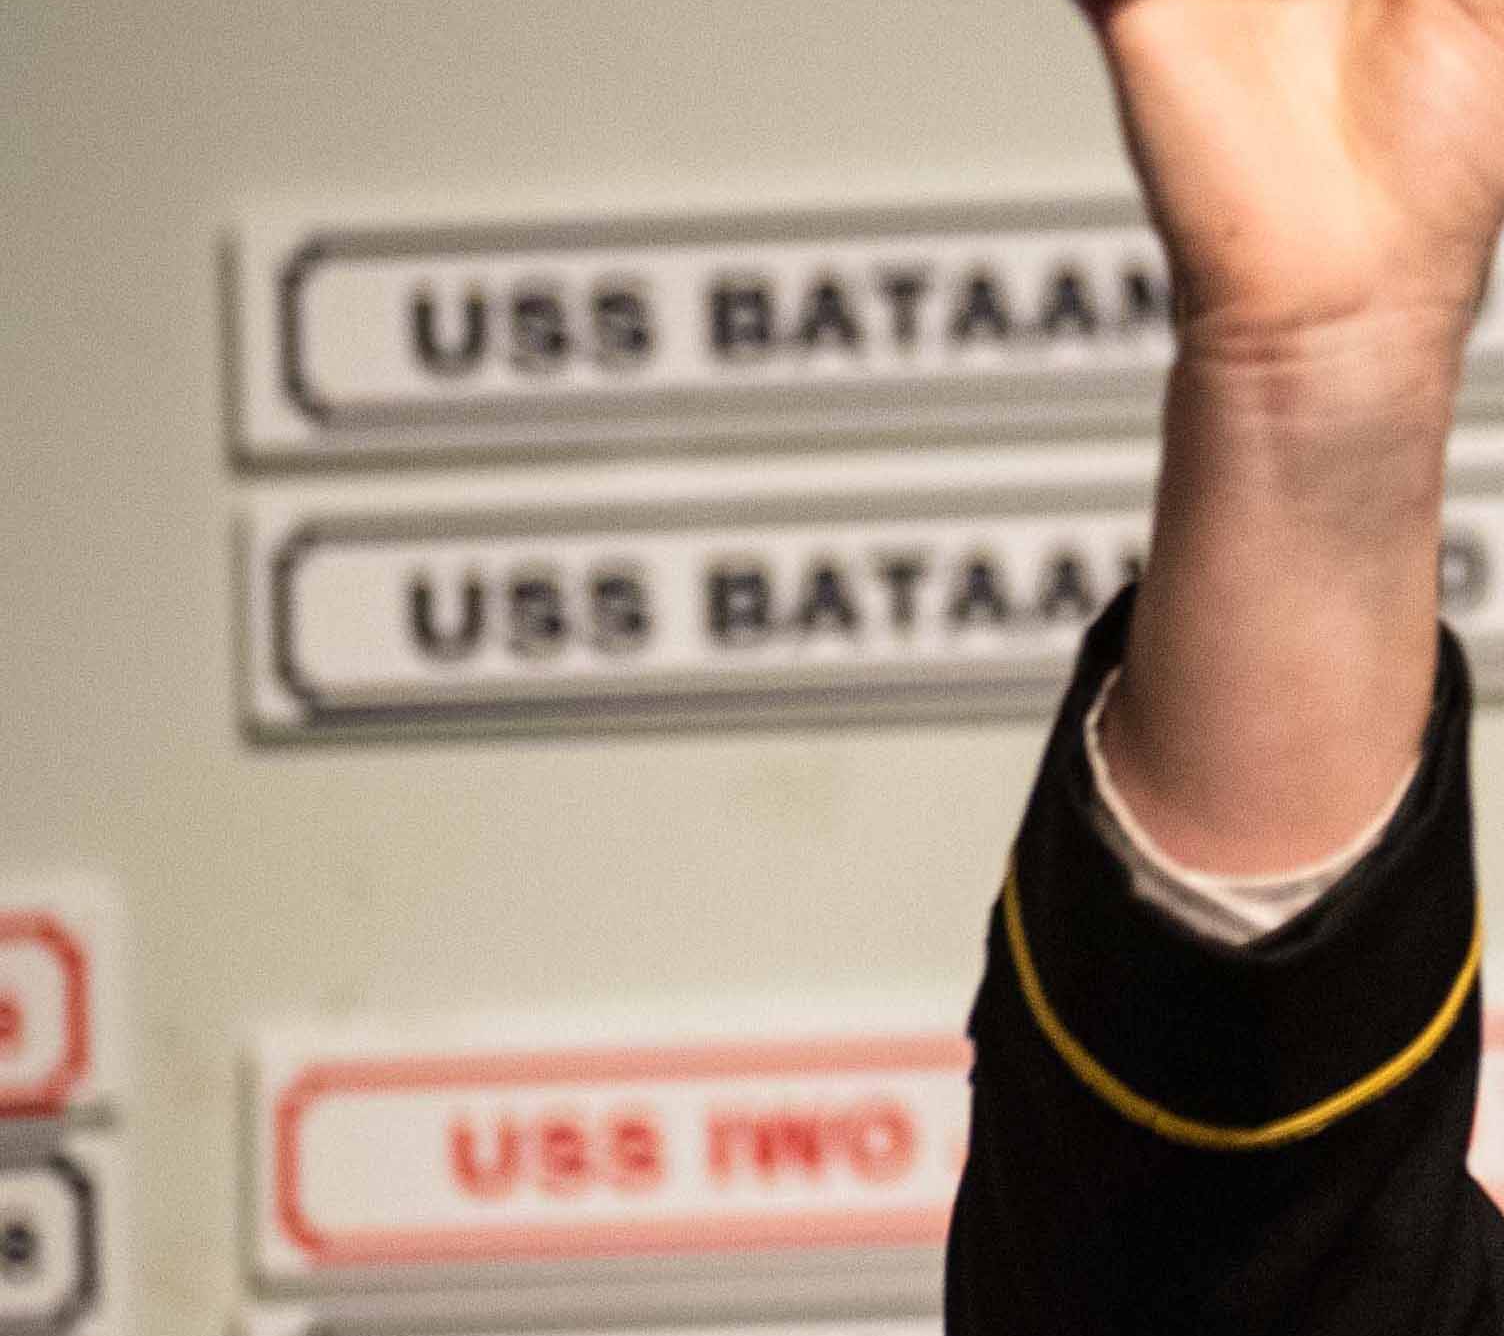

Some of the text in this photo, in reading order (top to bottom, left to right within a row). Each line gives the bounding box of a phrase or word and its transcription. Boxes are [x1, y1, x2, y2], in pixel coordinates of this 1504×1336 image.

[405, 271, 656, 380] USS
[403, 557, 656, 665] USS
[444, 1099, 668, 1203] USS
[702, 1093, 920, 1187] IWO
